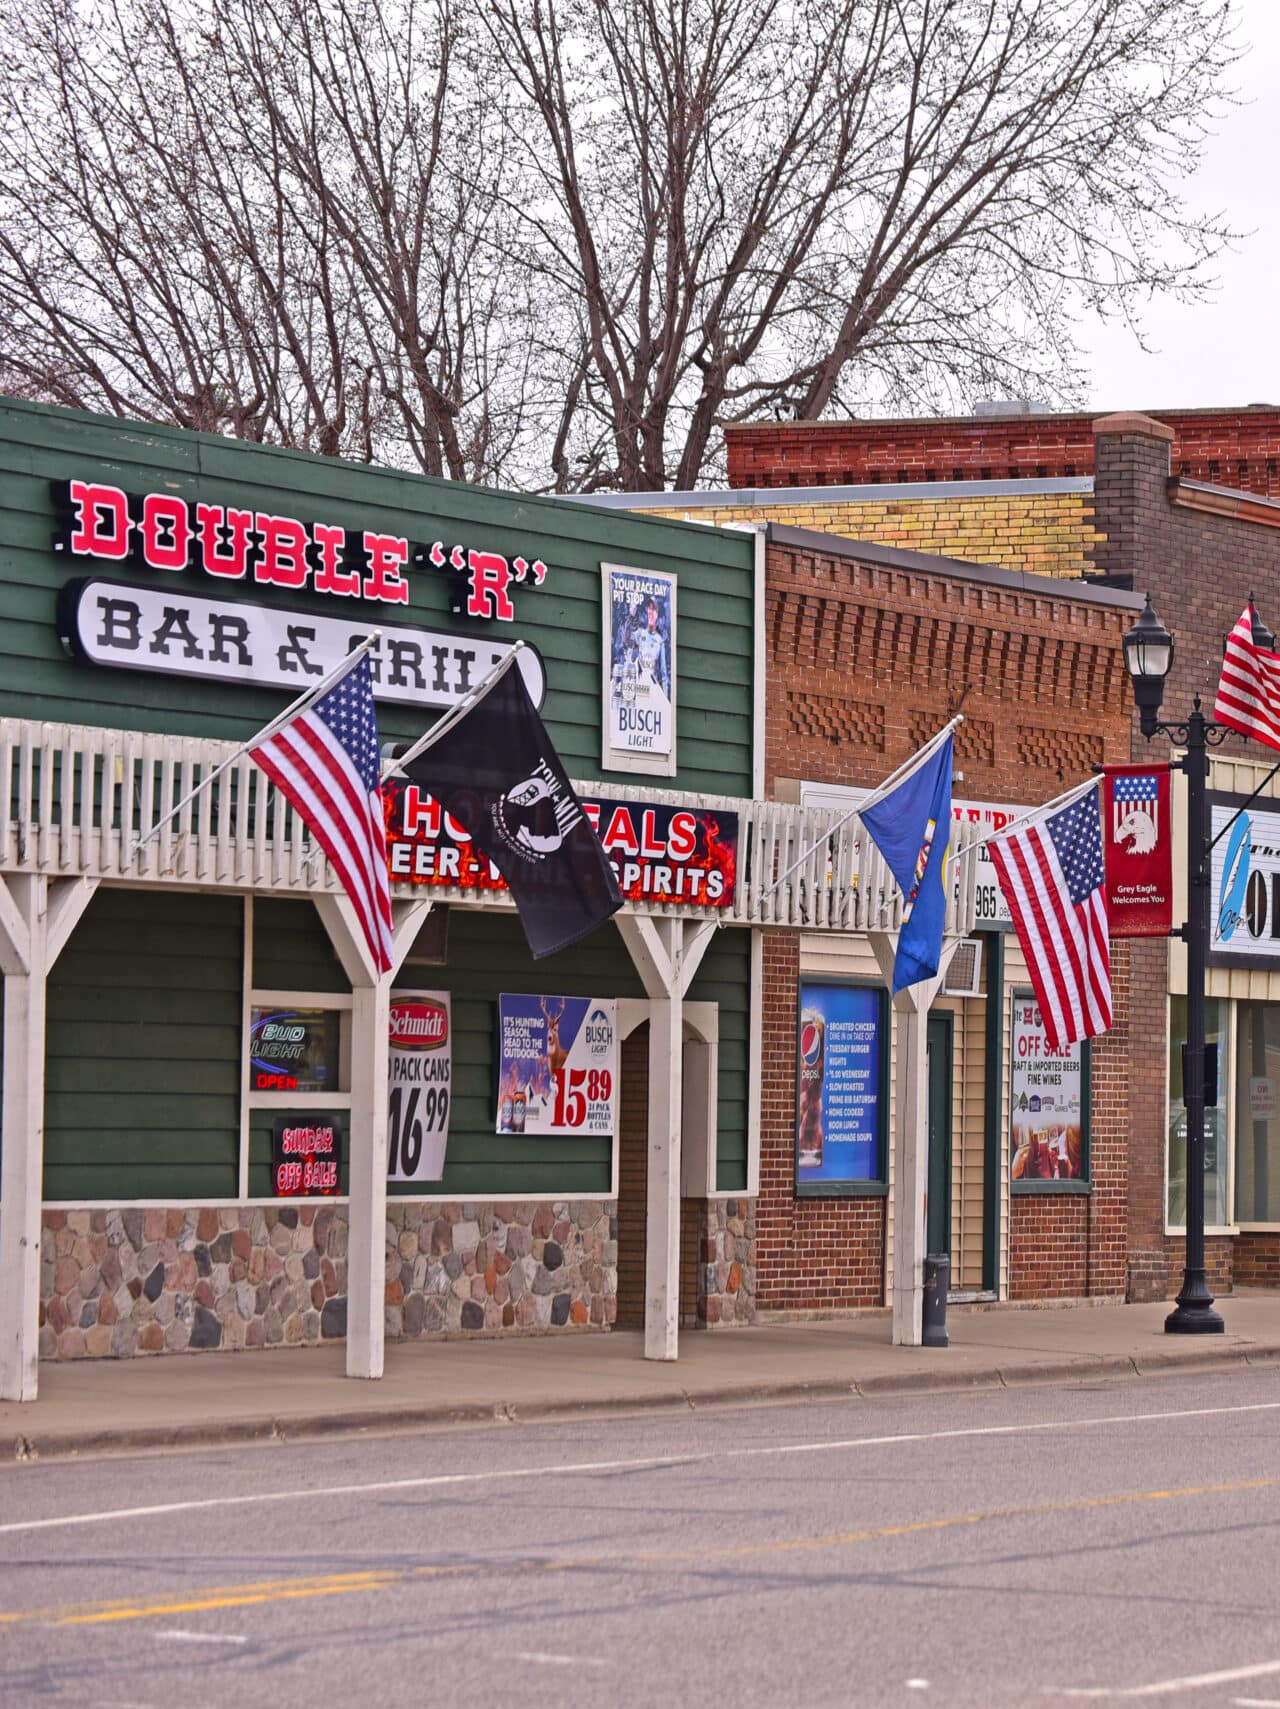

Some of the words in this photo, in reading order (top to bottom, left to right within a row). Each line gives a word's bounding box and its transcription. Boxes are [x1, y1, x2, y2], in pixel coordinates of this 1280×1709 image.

[70, 480, 408, 604] DOUBLE
[612, 577, 635, 593] YOUR
[635, 580, 653, 594] RACE
[654, 583, 667, 597] DAY
[613, 589, 624, 603] PIT
[626, 591, 645, 605] STOP
[97, 596, 253, 666] BAR
[276, 624, 324, 676] &
[619, 707, 662, 736] BUSCH
[628, 734, 653, 748] LIGHT
[391, 842, 460, 877] EER
[1117, 885, 1135, 895] Grey
[1136, 884, 1158, 894] Eagle
[1112, 896, 1150, 905] Welcomes
[1150, 895, 1165, 903] You
[388, 1007, 444, 1037] Schmidt
[503, 1016, 514, 1027] IT'S
[515, 1017, 545, 1029] HUNTING
[854, 1022, 876, 1032] CHICKEN
[261, 1024, 305, 1041] BUD
[586, 1026, 613, 1045] BUSCH
[829, 1031, 840, 1041] DINE
[841, 1032, 846, 1040] IN
[853, 1031, 865, 1041] TAKE
[865, 1031, 875, 1041] OUT
[250, 1040, 305, 1059] LIGHT
[503, 1038, 521, 1048] HEAD
[522, 1038, 531, 1048] TO
[531, 1039, 543, 1049] THE
[591, 1044, 608, 1054] LIGHT
[829, 1044, 850, 1054] TUESDAY
[850, 1044, 870, 1054] BURGER
[1018, 1035, 1041, 1057] OFF
[394, 1057, 421, 1081] PACK
[423, 1057, 450, 1082] CANS
[1013, 1060, 1028, 1072] RAFT
[1028, 1061, 1033, 1071] &
[1033, 1060, 1062, 1072] IMPORTED
[1062, 1061, 1080, 1072] BEERS
[256, 1073, 298, 1090] OPEN
[841, 1070, 870, 1079] WEDNESDAY
[1027, 1073, 1042, 1085] FINE
[1042, 1074, 1062, 1086] WINES
[828, 1082, 842, 1091] SLOW
[843, 1082, 864, 1091] ROASTED
[550, 1068, 587, 1128] 15
[587, 1068, 612, 1102] 89
[828, 1095, 843, 1104] PRIME
[853, 1095, 877, 1104] SATURDAY
[595, 1103, 610, 1112] PACK
[828, 1107, 843, 1117] HOME
[587, 1112, 612, 1121] BOTTLES
[387, 1087, 423, 1177] 16
[426, 1087, 449, 1132] 99
[282, 1126, 334, 1155] SUNDAY
[277, 1162, 303, 1191] OFF
[303, 1161, 337, 1189] SALE
